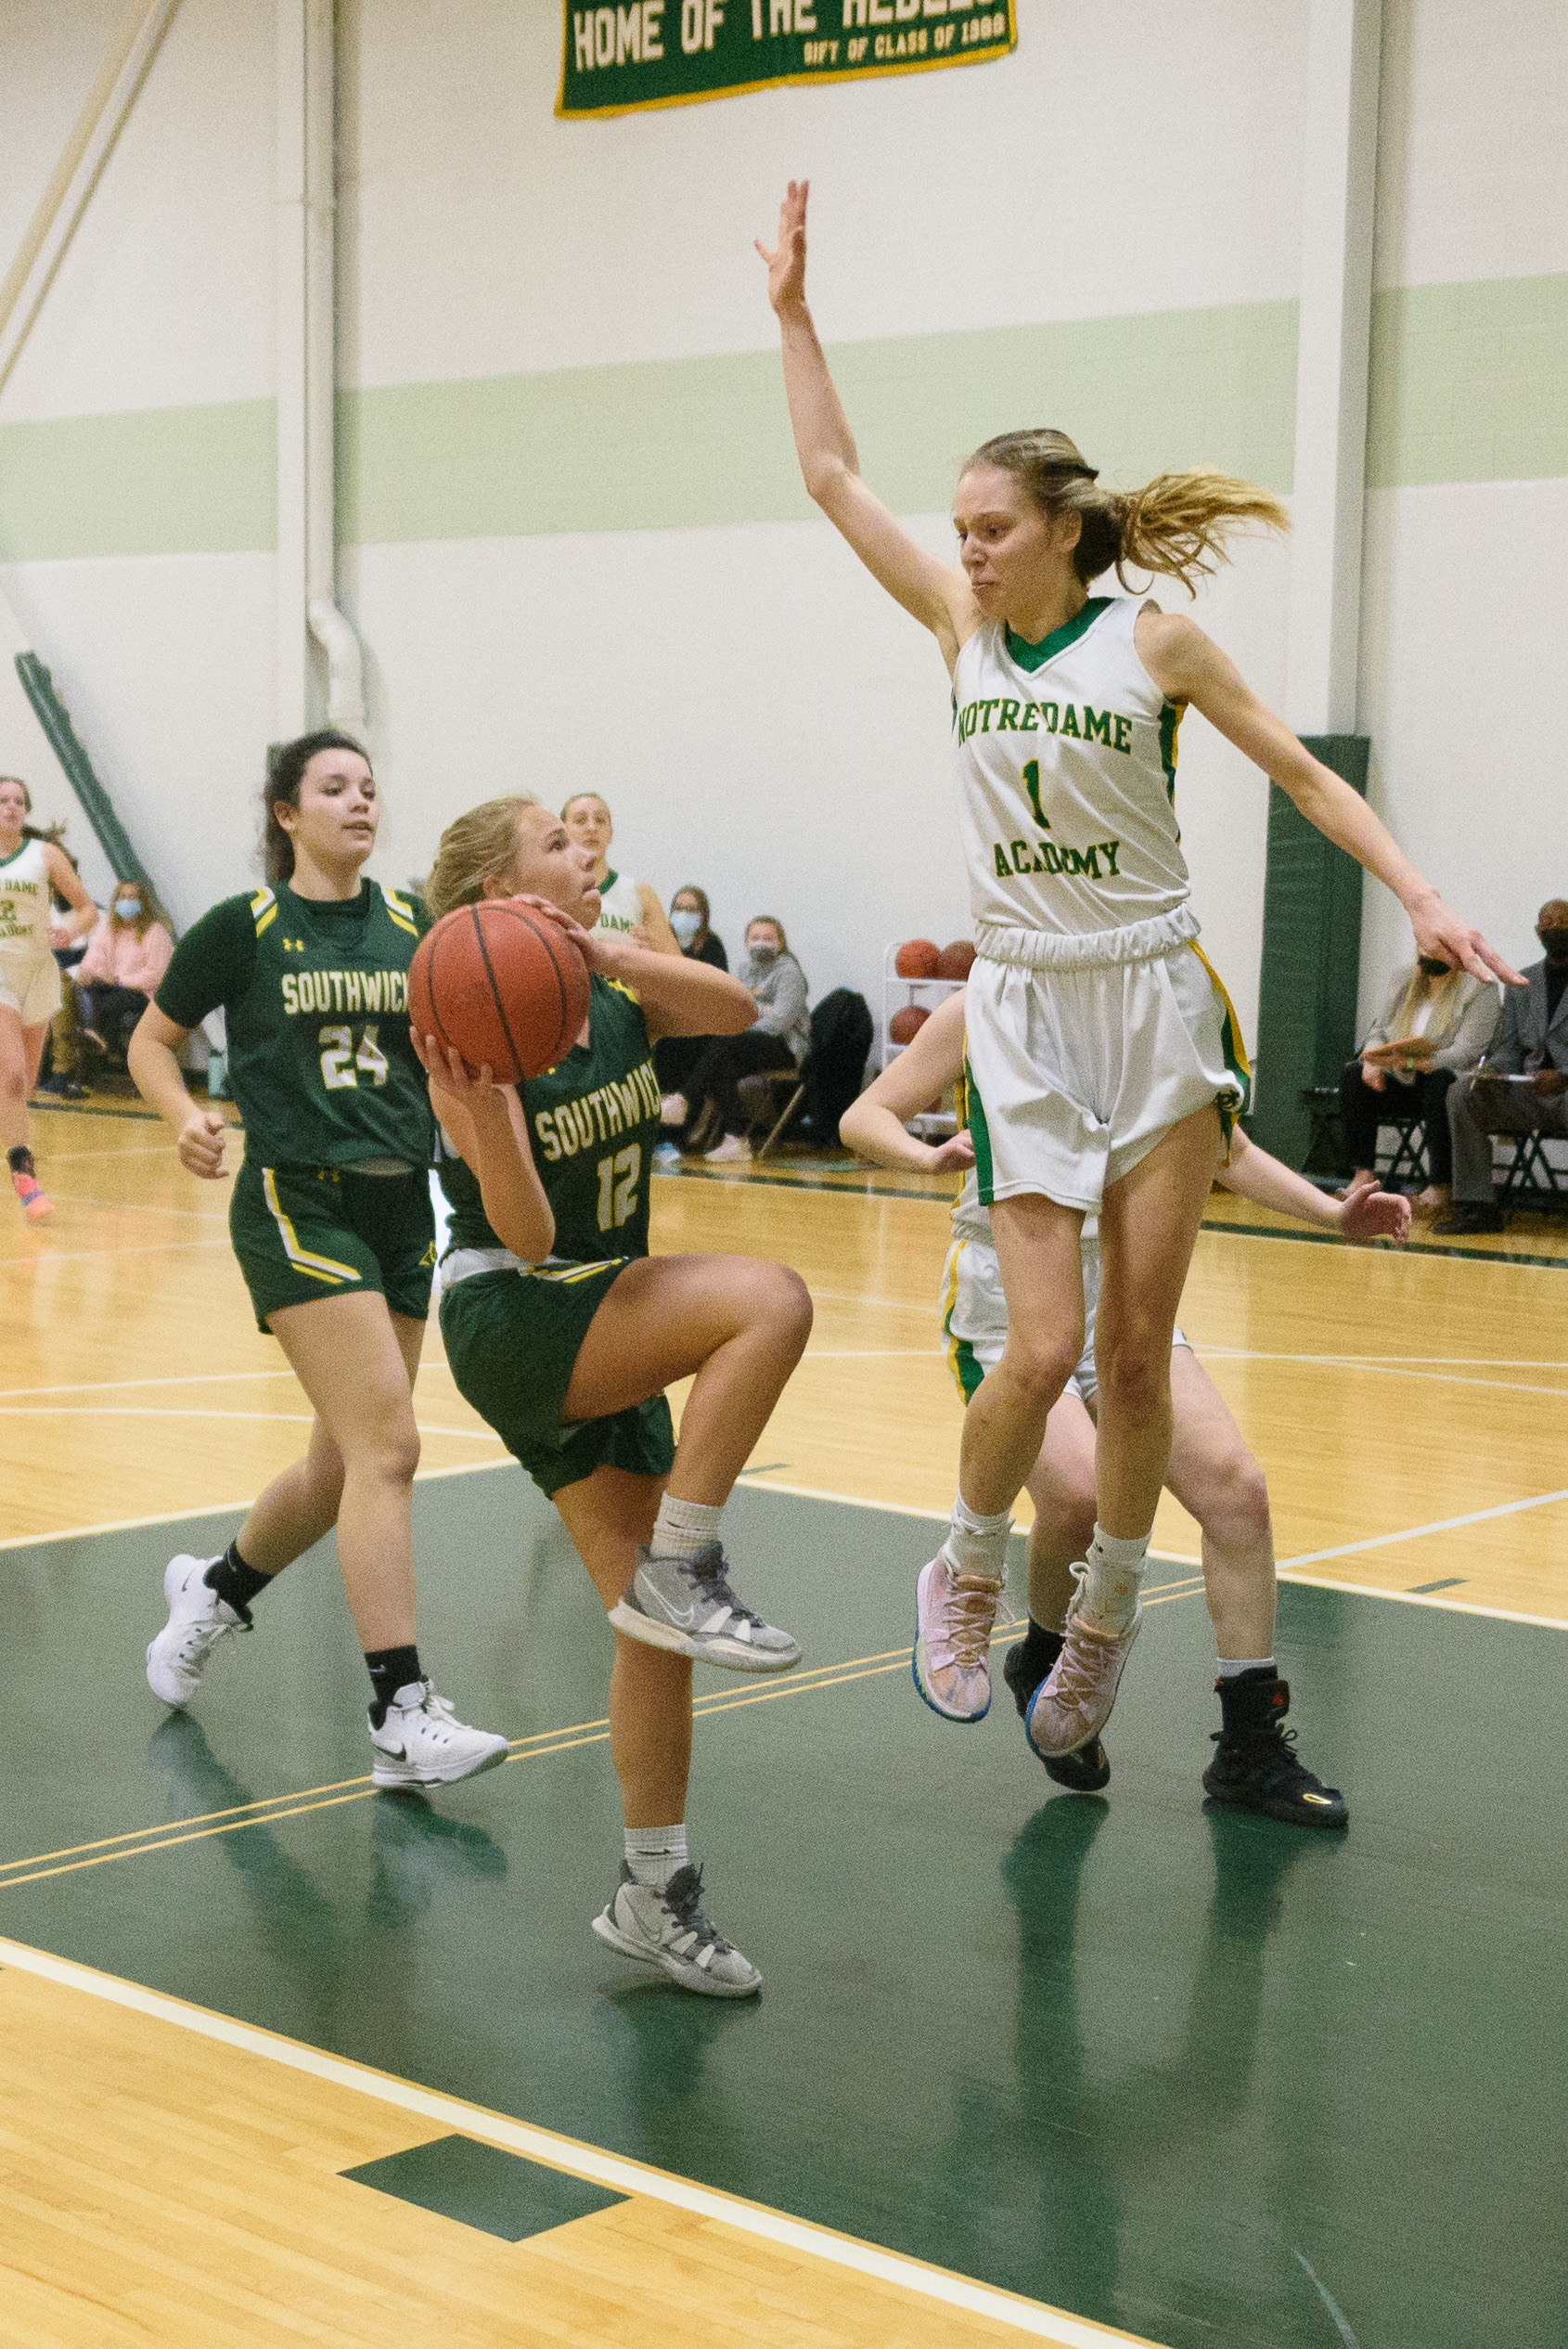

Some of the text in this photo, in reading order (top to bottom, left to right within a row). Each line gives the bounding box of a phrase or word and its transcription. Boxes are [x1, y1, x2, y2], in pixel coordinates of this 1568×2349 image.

[573, 0, 665, 71] HOME
[681, 0, 725, 55] OF
[847, 36, 869, 62] OF
[875, 29, 929, 58] CLASS
[933, 23, 956, 50] OF
[958, 698, 1133, 755] NOTRE DAME
[1022, 758, 1051, 829] 1
[319, 1025, 389, 1090] 24
[597, 1142, 642, 1232] 12
